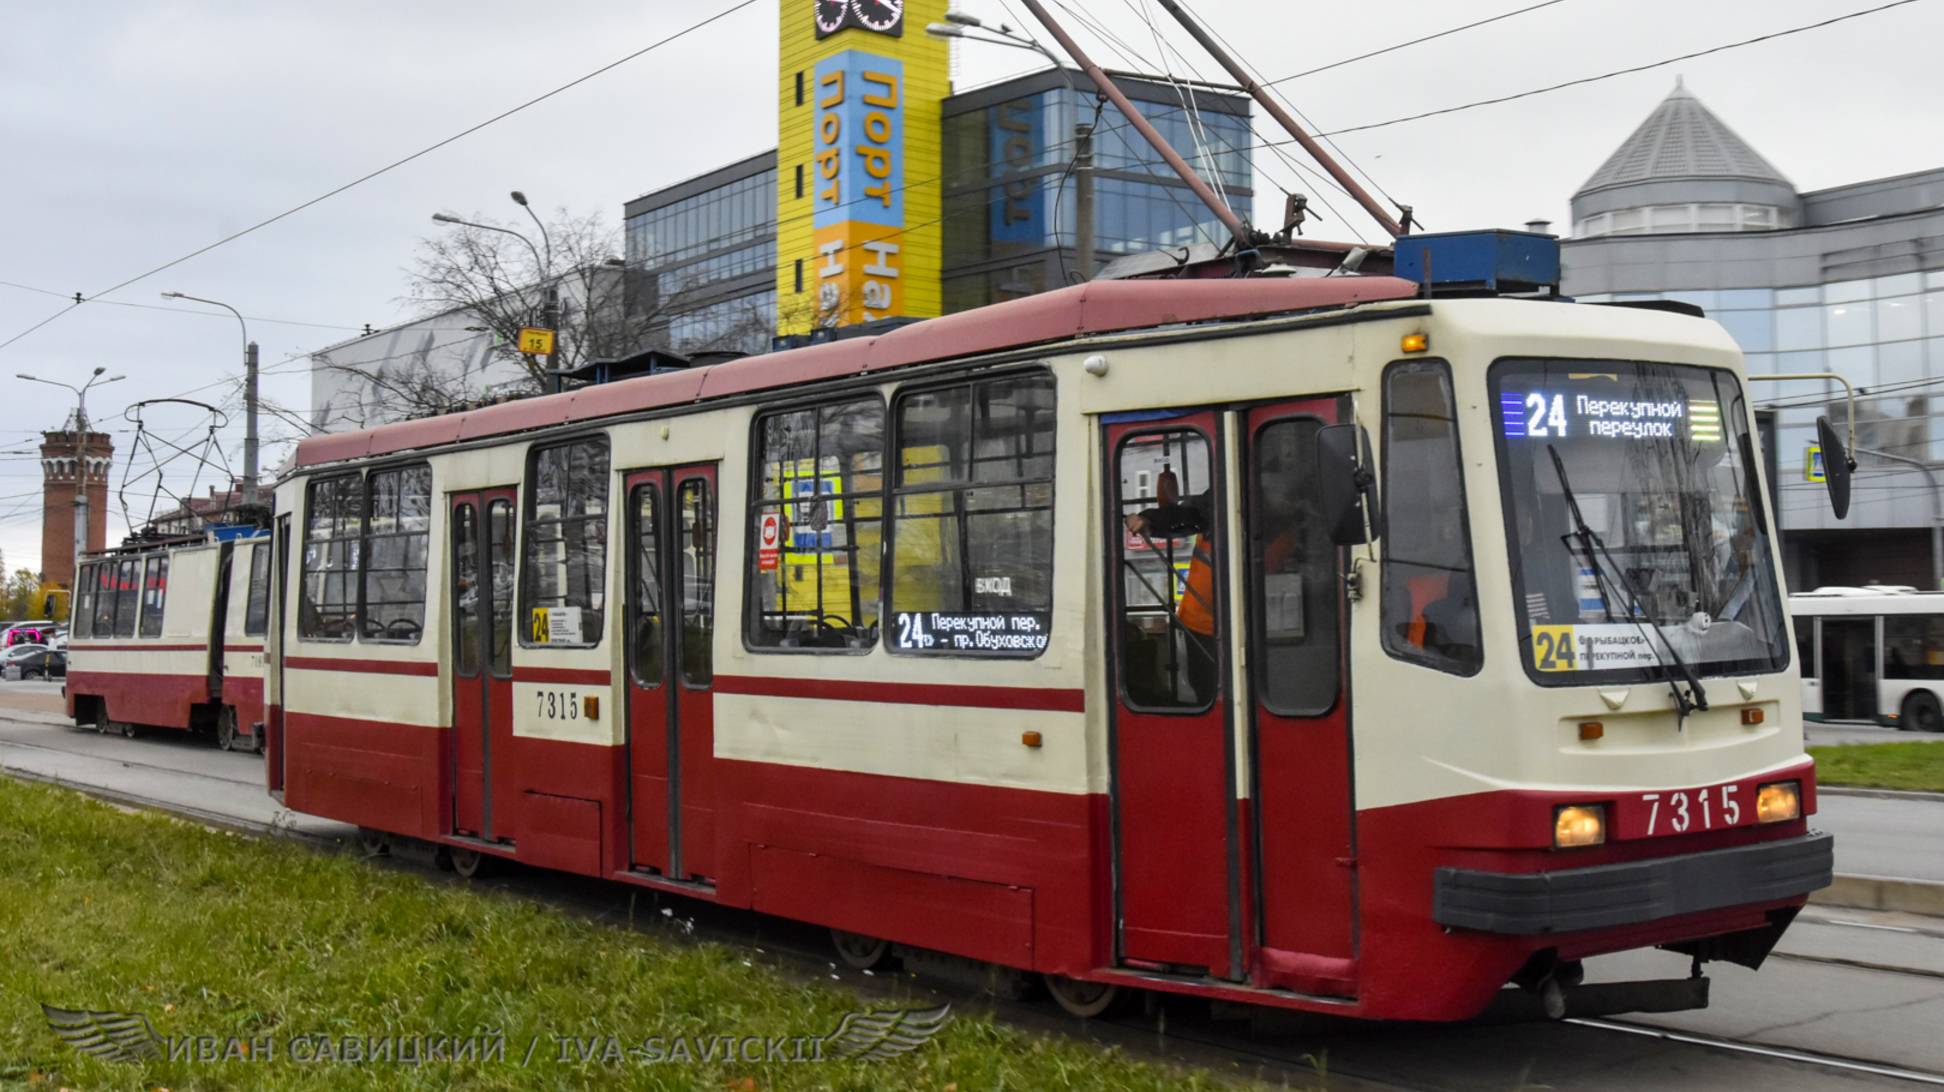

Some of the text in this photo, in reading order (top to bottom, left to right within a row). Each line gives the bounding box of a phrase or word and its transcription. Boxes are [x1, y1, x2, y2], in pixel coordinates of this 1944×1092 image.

[815, 69, 845, 206] Порт
[855, 70, 898, 209] Порт
[1526, 393, 1568, 437] 24
[1576, 394, 1683, 418] Перекупной
[1589, 420, 1673, 437] переулок
[533, 612, 550, 643] 24
[898, 613, 924, 649] 24
[931, 613, 1041, 631] Перекупной пер.
[1536, 631, 1576, 669] 24
[537, 691, 577, 720] 7315
[1642, 785, 1740, 835] 7315
